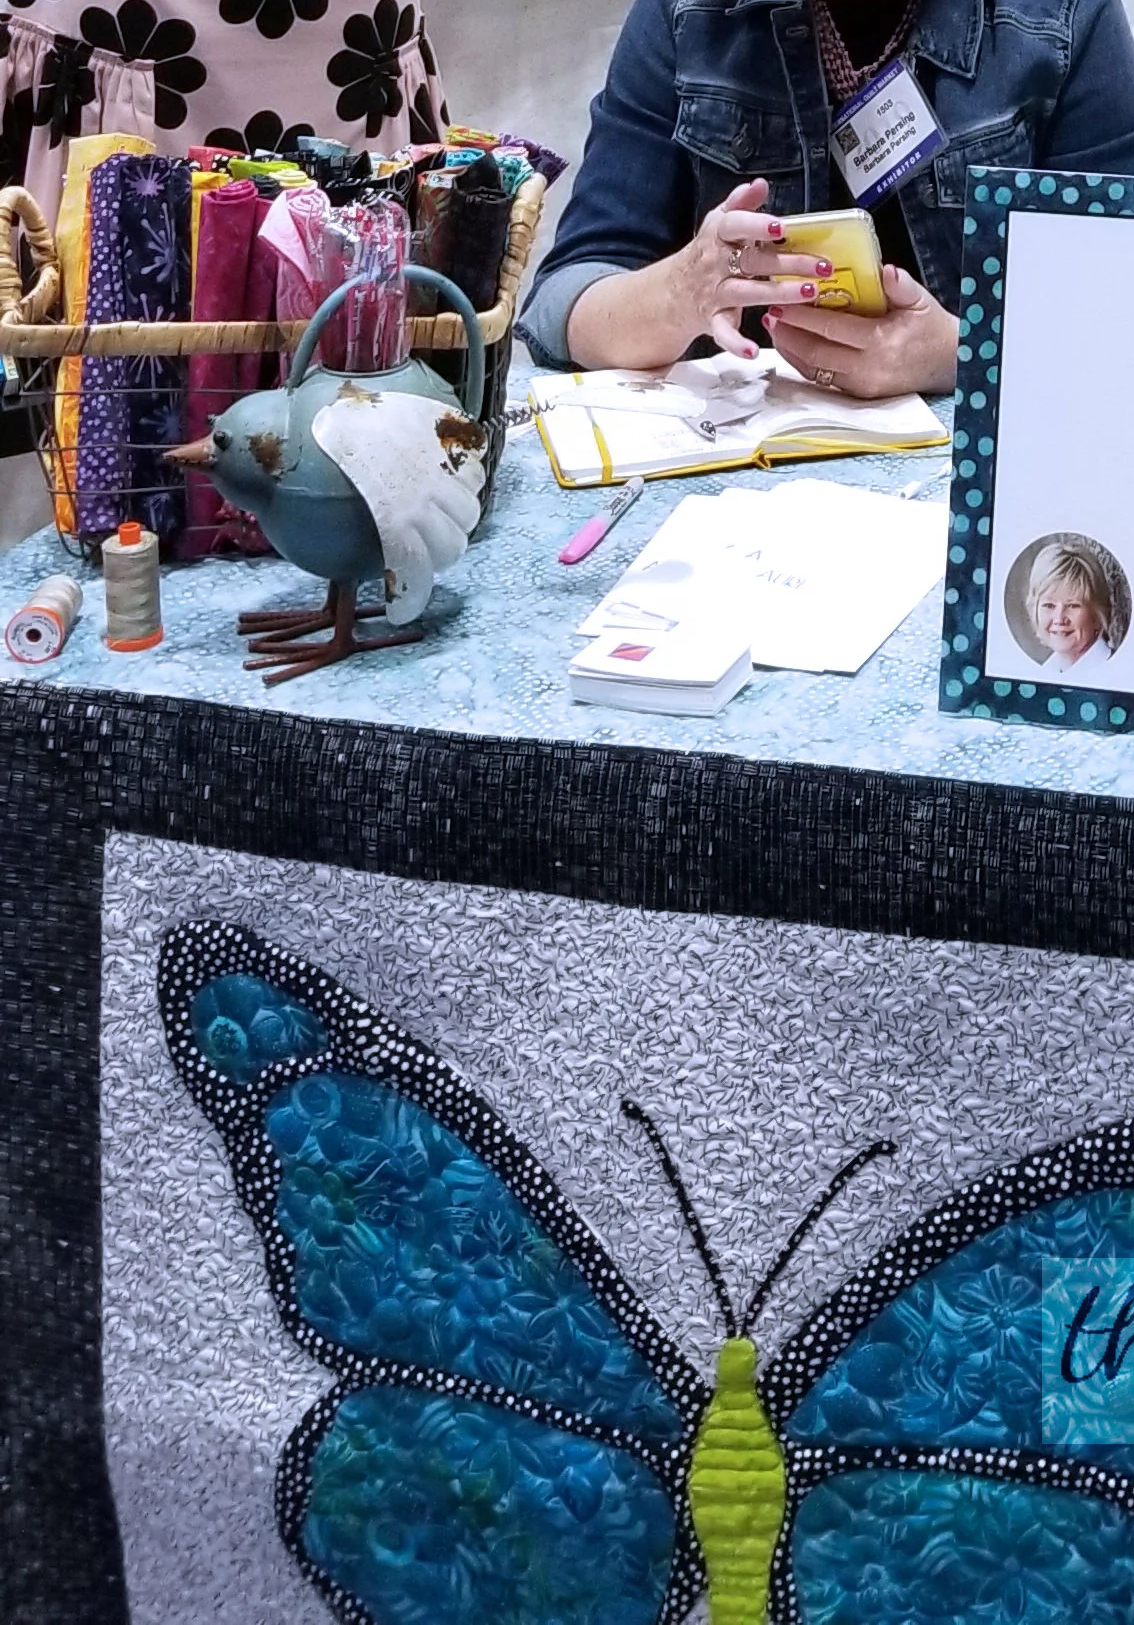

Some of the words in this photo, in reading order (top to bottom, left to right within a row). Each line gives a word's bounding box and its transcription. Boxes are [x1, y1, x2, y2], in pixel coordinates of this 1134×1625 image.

[853, 135, 887, 167] Barbara
[884, 110, 916, 139] Persing
[863, 146, 892, 173] Barbara
[891, 125, 917, 150] Persing
[876, 151, 922, 193] EXHIBITOR
